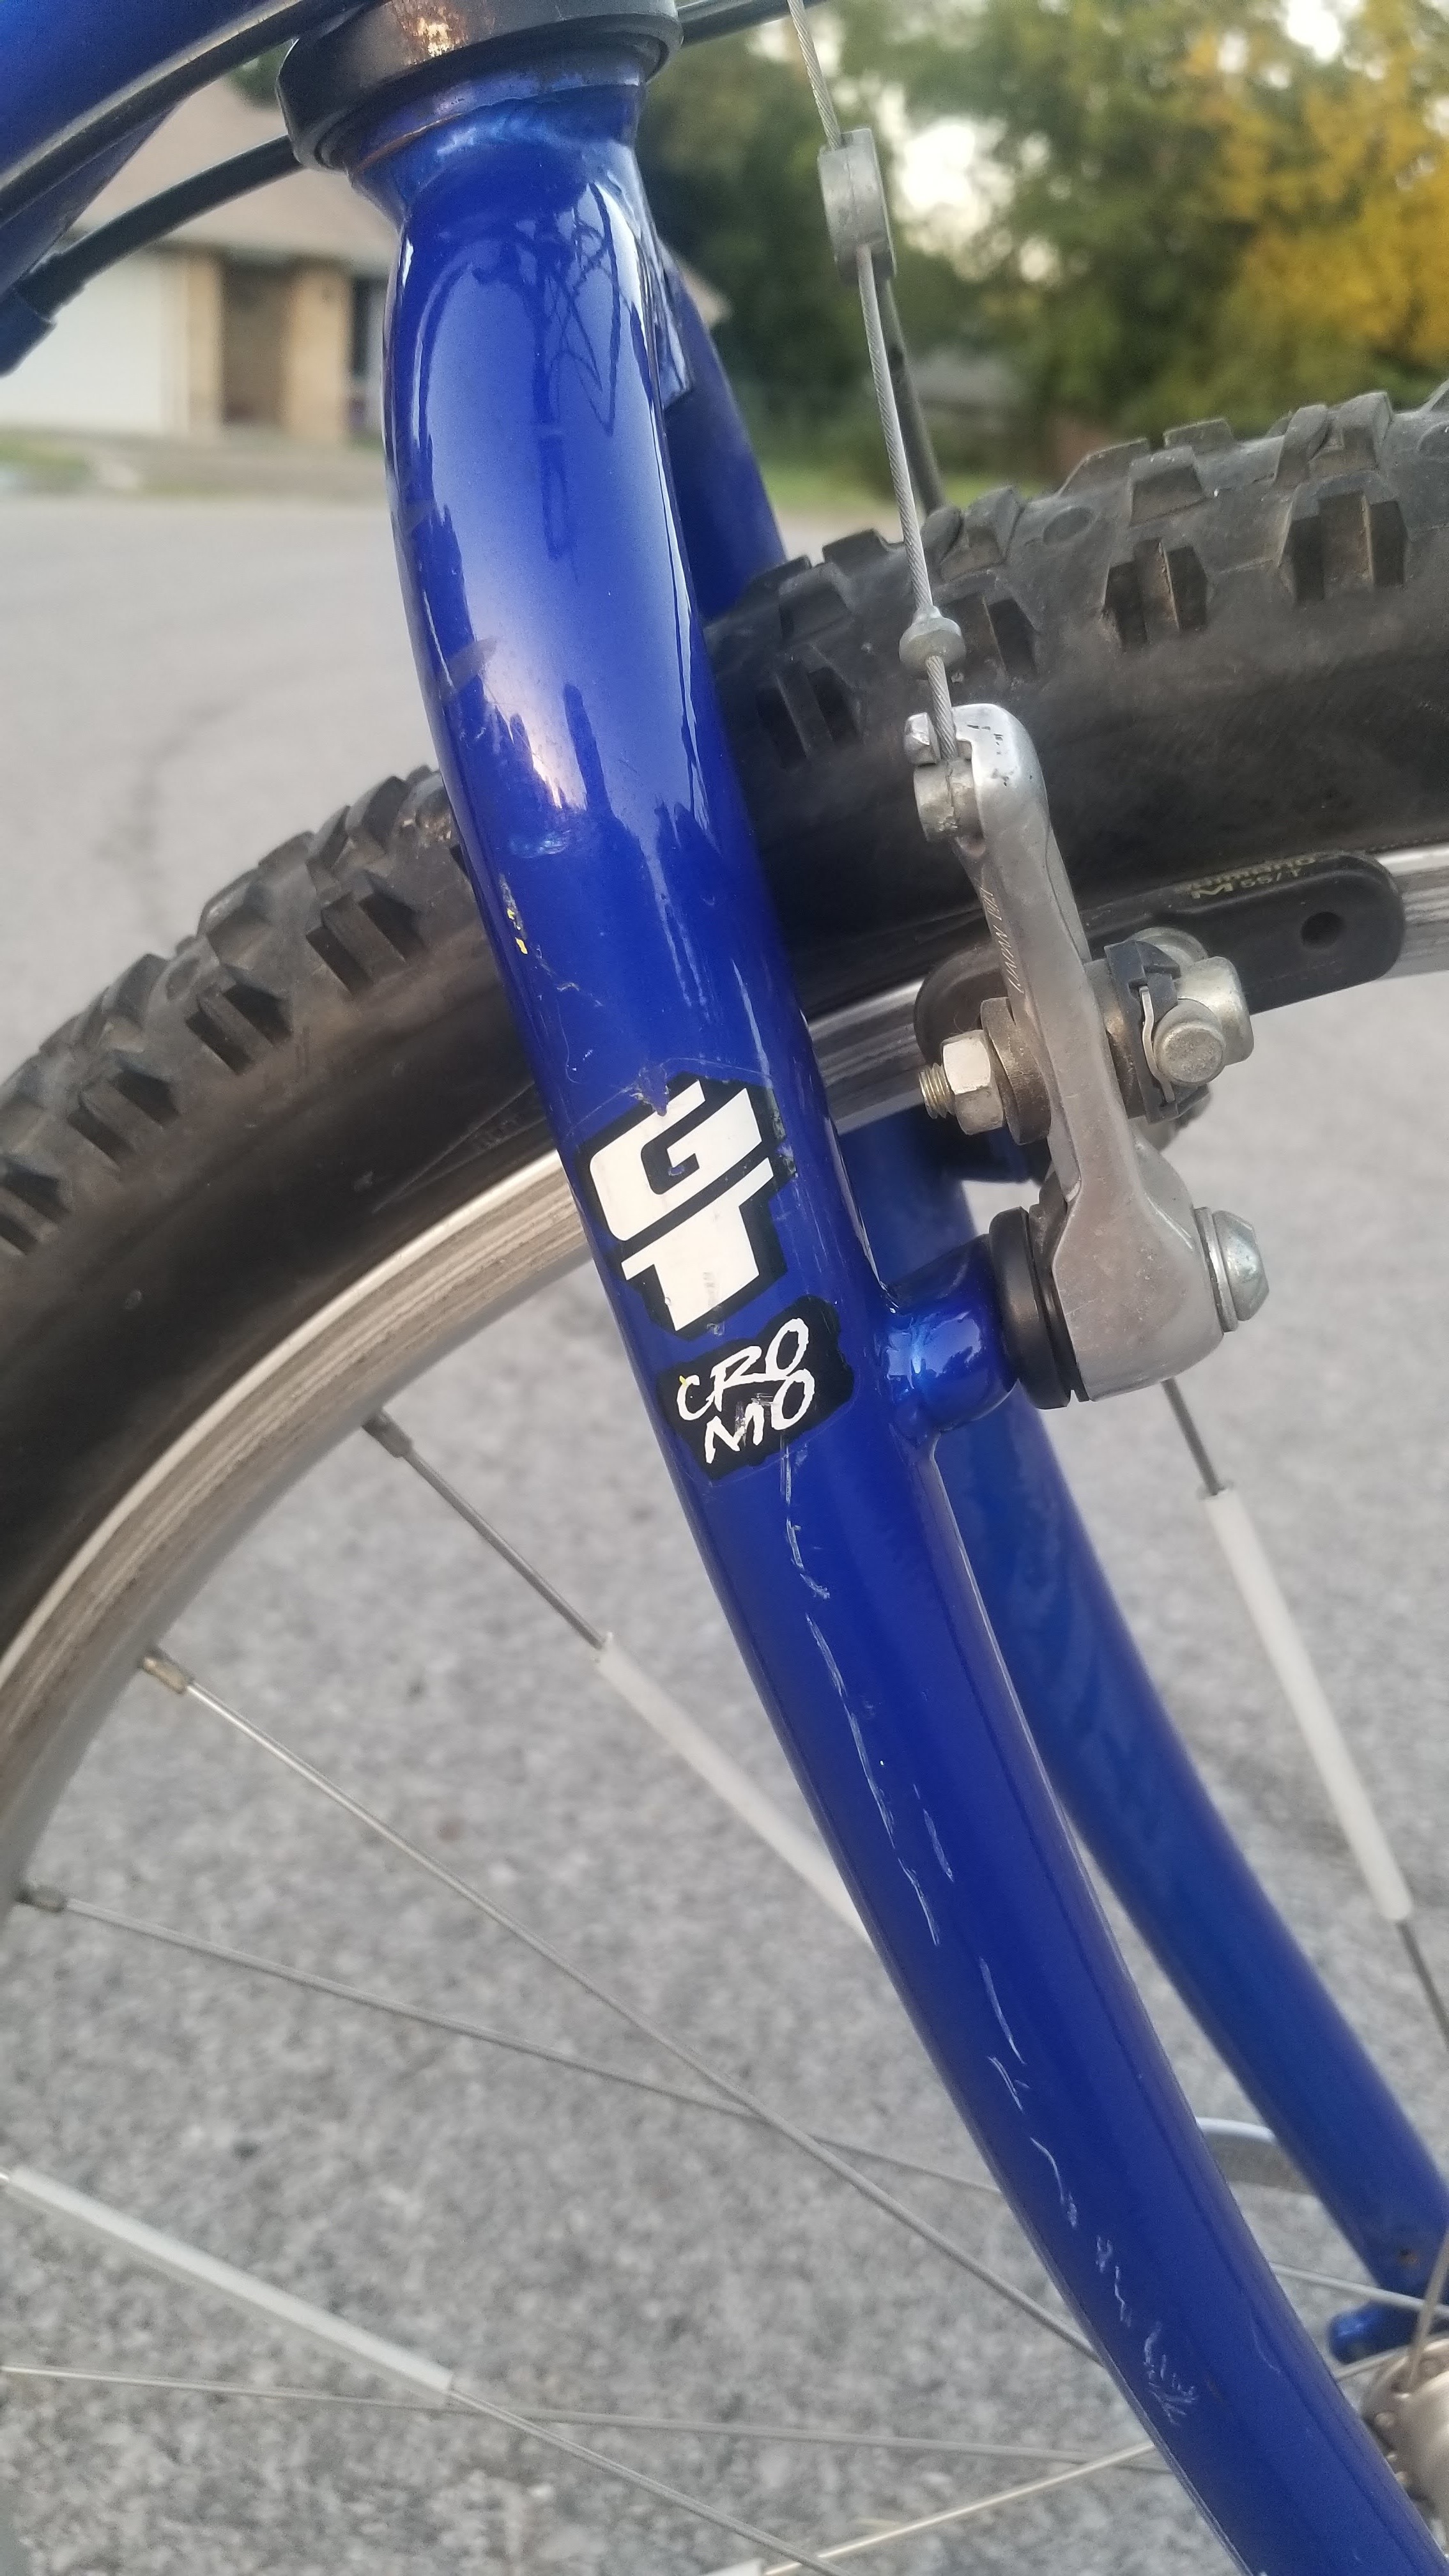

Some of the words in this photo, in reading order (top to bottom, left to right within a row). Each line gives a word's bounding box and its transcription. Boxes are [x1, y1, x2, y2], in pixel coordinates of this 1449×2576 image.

[588, 1080, 774, 1331] GT
[676, 1317, 809, 1421] CRO
[705, 1368, 815, 1464] MO
